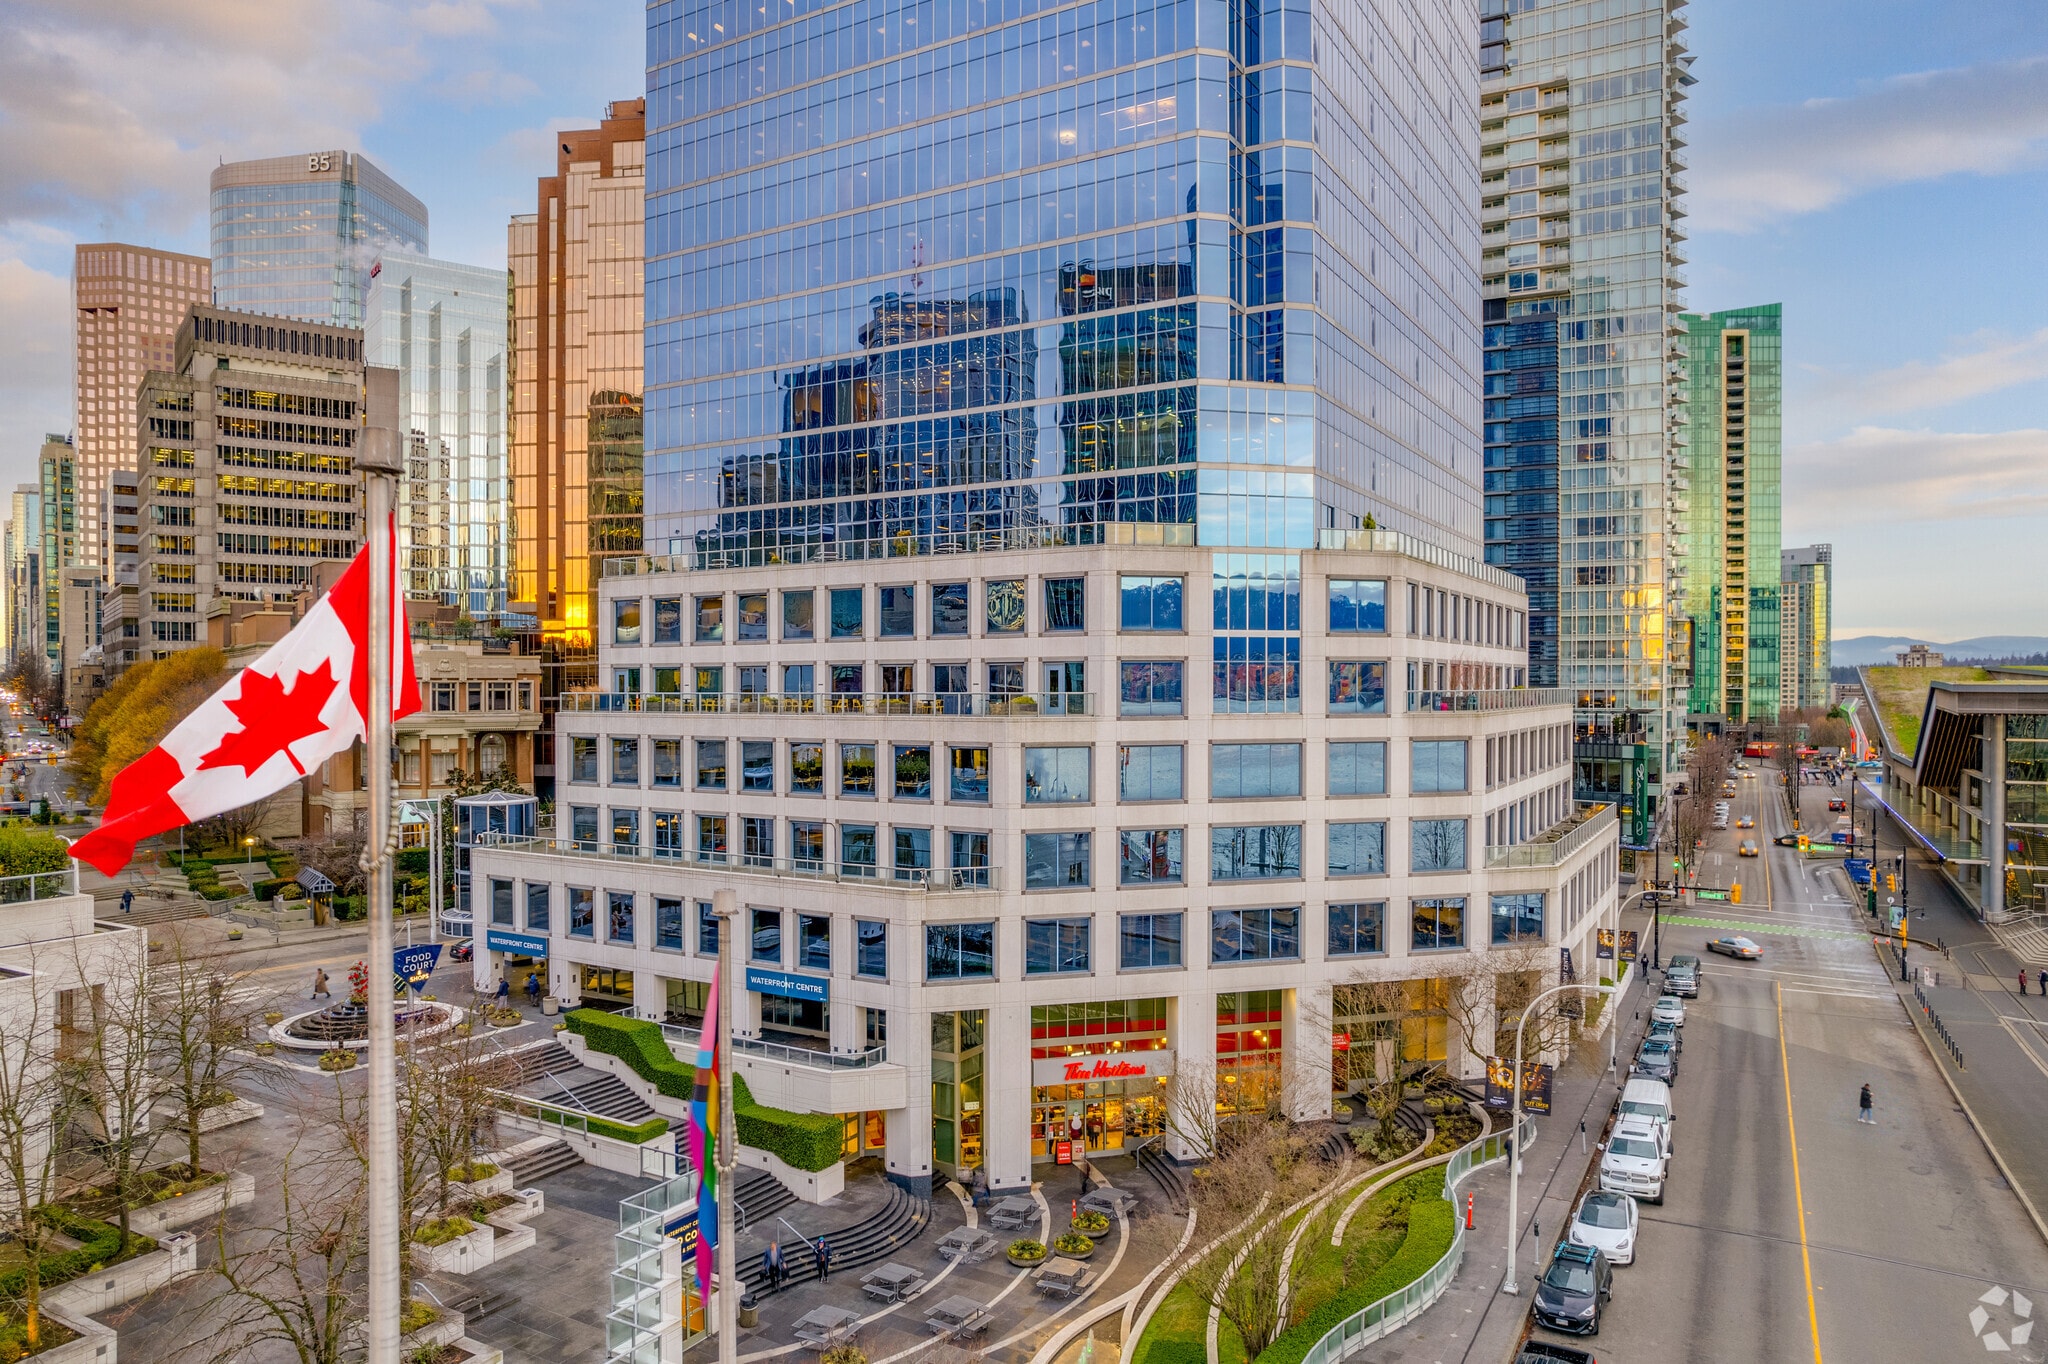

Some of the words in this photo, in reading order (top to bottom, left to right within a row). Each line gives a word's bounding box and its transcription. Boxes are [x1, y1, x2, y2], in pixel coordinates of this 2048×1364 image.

[309, 155, 331, 171] B5
[490, 936, 523, 948] WATERFRONT
[523, 941, 544, 951] CENTRE
[405, 952, 431, 964] FOOD
[402, 959, 434, 973] COURT
[409, 972, 430, 983] SHOPS
[750, 975, 795, 989] WATERFRONT
[795, 982, 823, 994] CENTRE
[1063, 1062, 1091, 1081] Tim
[1092, 1060, 1146, 1078] Hortons
